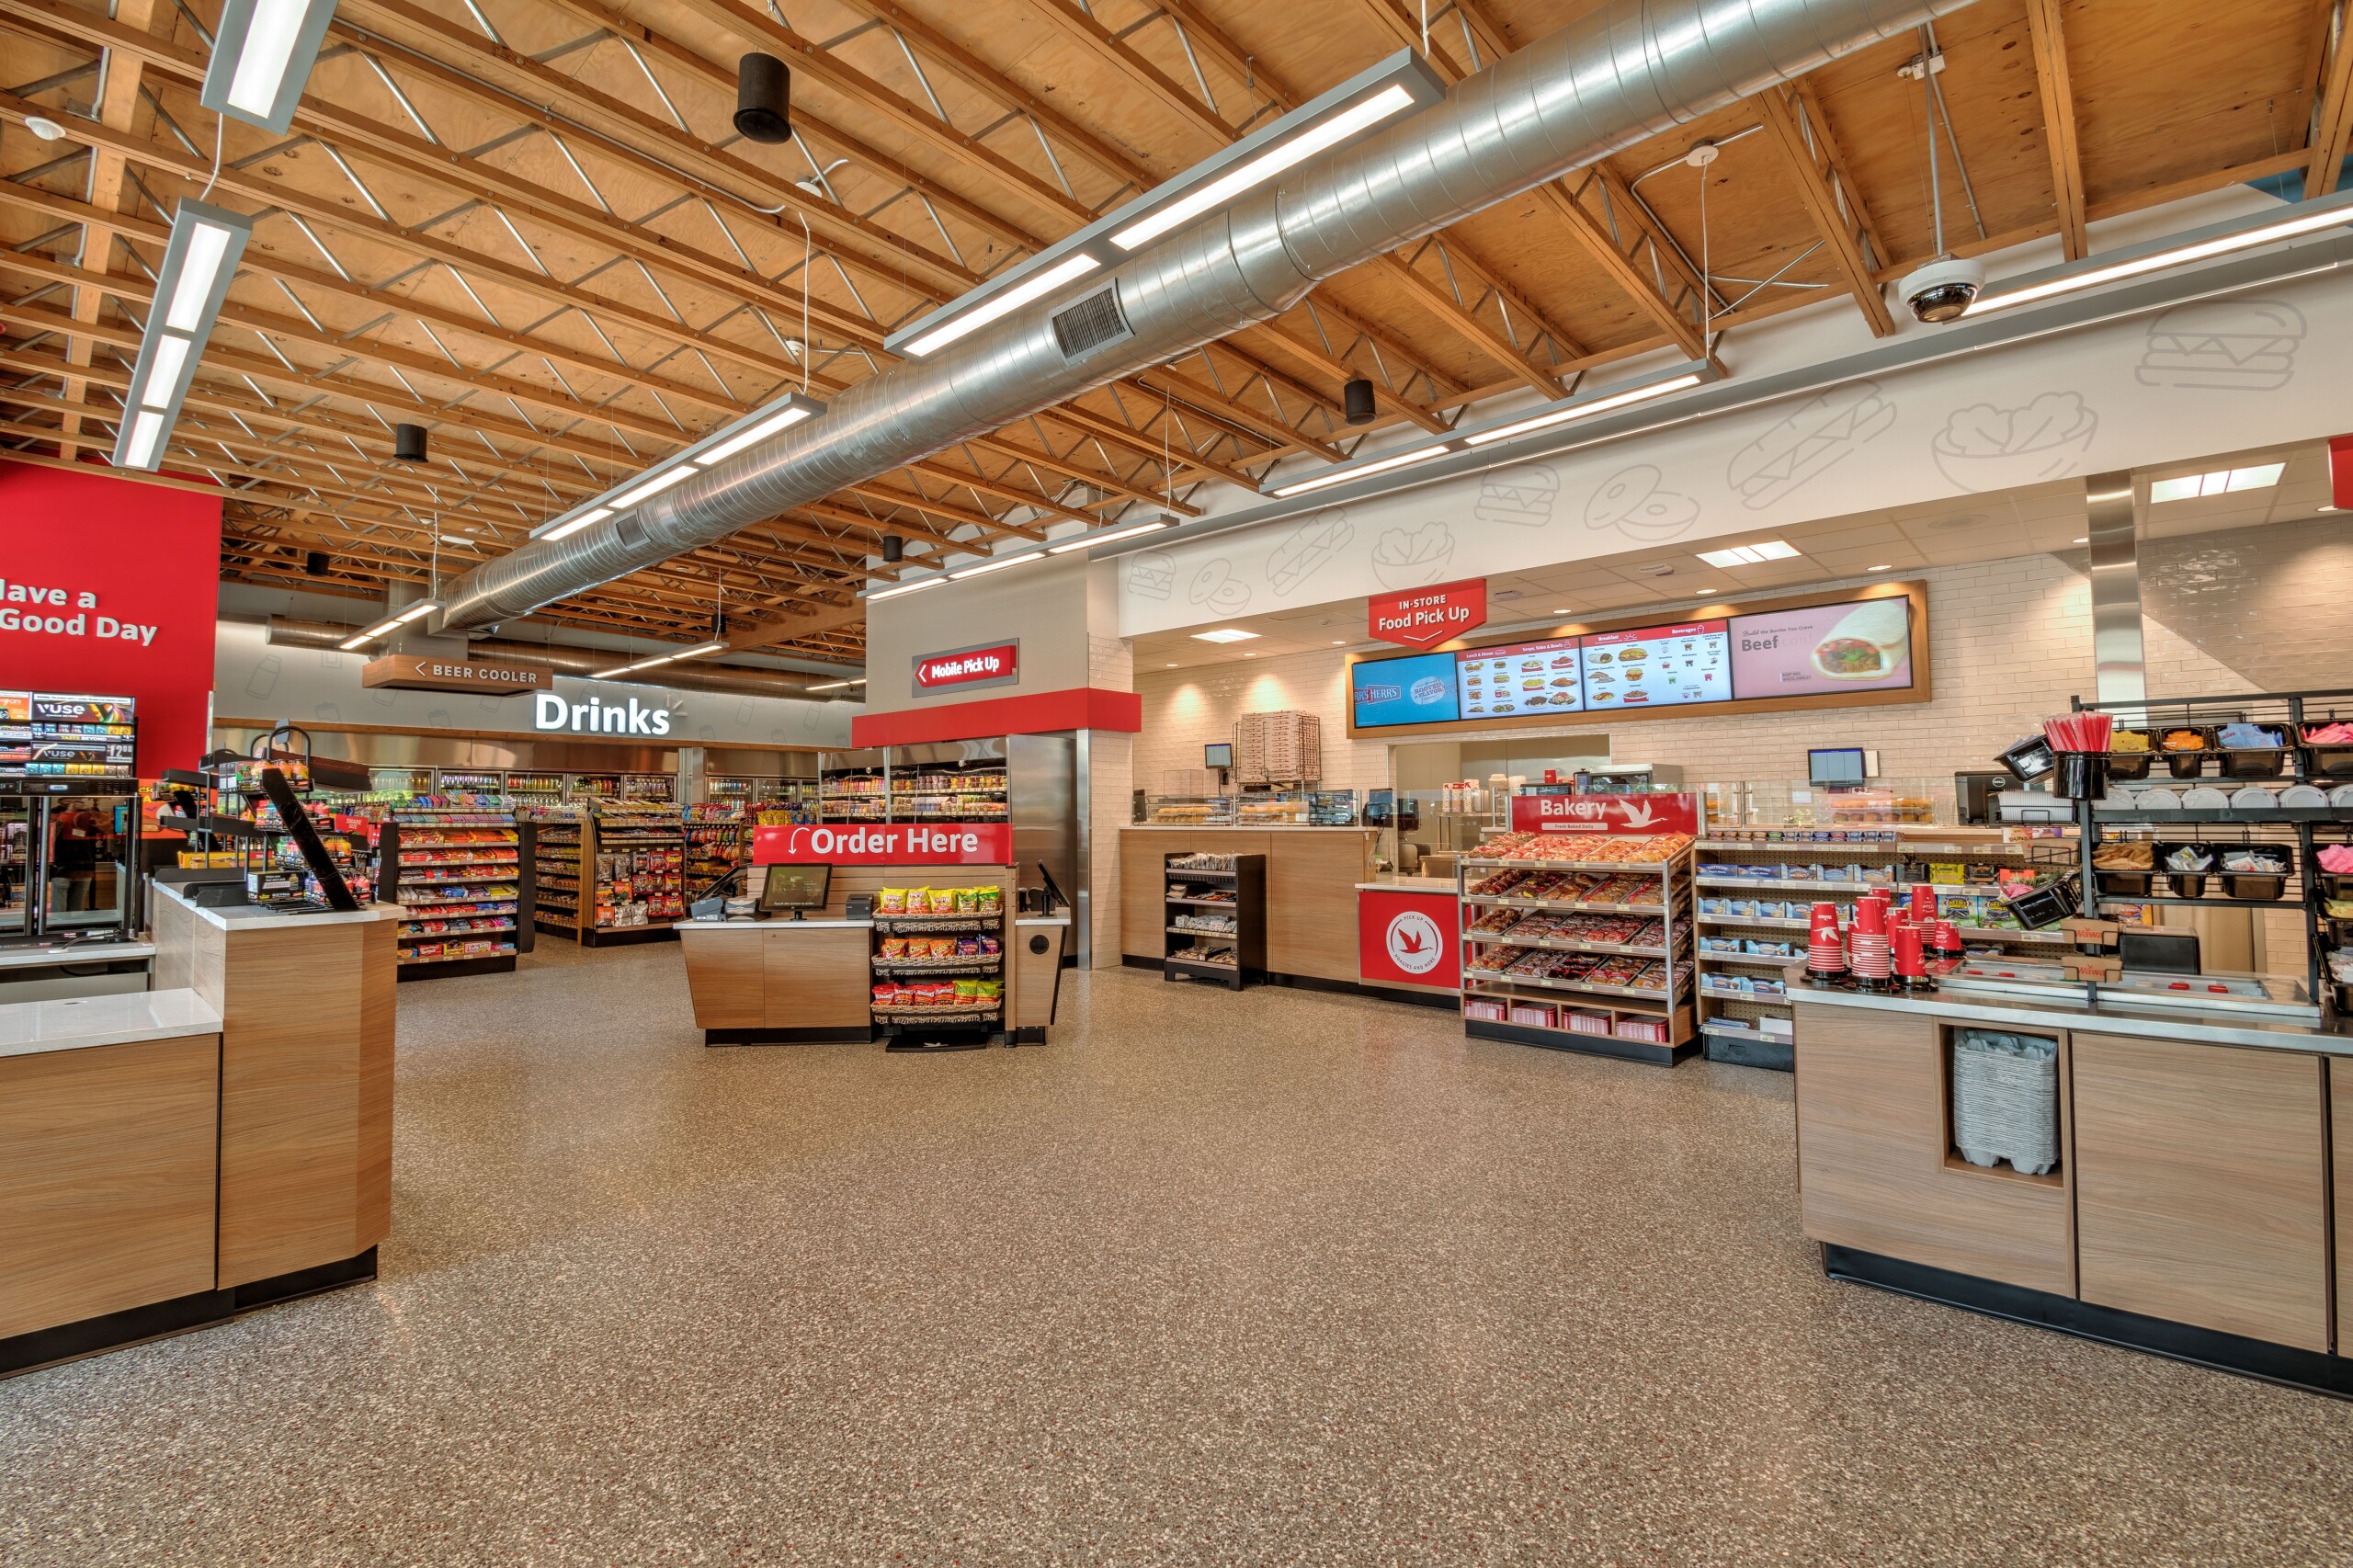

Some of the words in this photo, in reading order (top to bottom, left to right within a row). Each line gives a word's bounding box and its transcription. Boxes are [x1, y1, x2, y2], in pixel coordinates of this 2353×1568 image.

[77, 591, 97, 609] a
[1399, 595, 1447, 610] IN-STORE
[0, 608, 85, 636] Good
[96, 616, 158, 647] Day
[1379, 613, 1412, 631] Food
[1415, 608, 1445, 626] Pick
[1449, 606, 1470, 623] Up
[1741, 635, 1779, 652] Beef
[433, 665, 472, 678] BEER
[479, 669, 537, 684] COOLER
[931, 661, 962, 679] Mobile
[963, 657, 984, 674] Pick
[984, 656, 1000, 672] Up
[1414, 682, 1442, 694] ROOTED
[535, 693, 670, 735] Drinks
[1540, 799, 1607, 820] Bakery
[812, 826, 899, 854] Order
[907, 828, 979, 853] Here
[1394, 953, 1413, 970] HOAGIES
[1425, 957, 1436, 968] MORE
